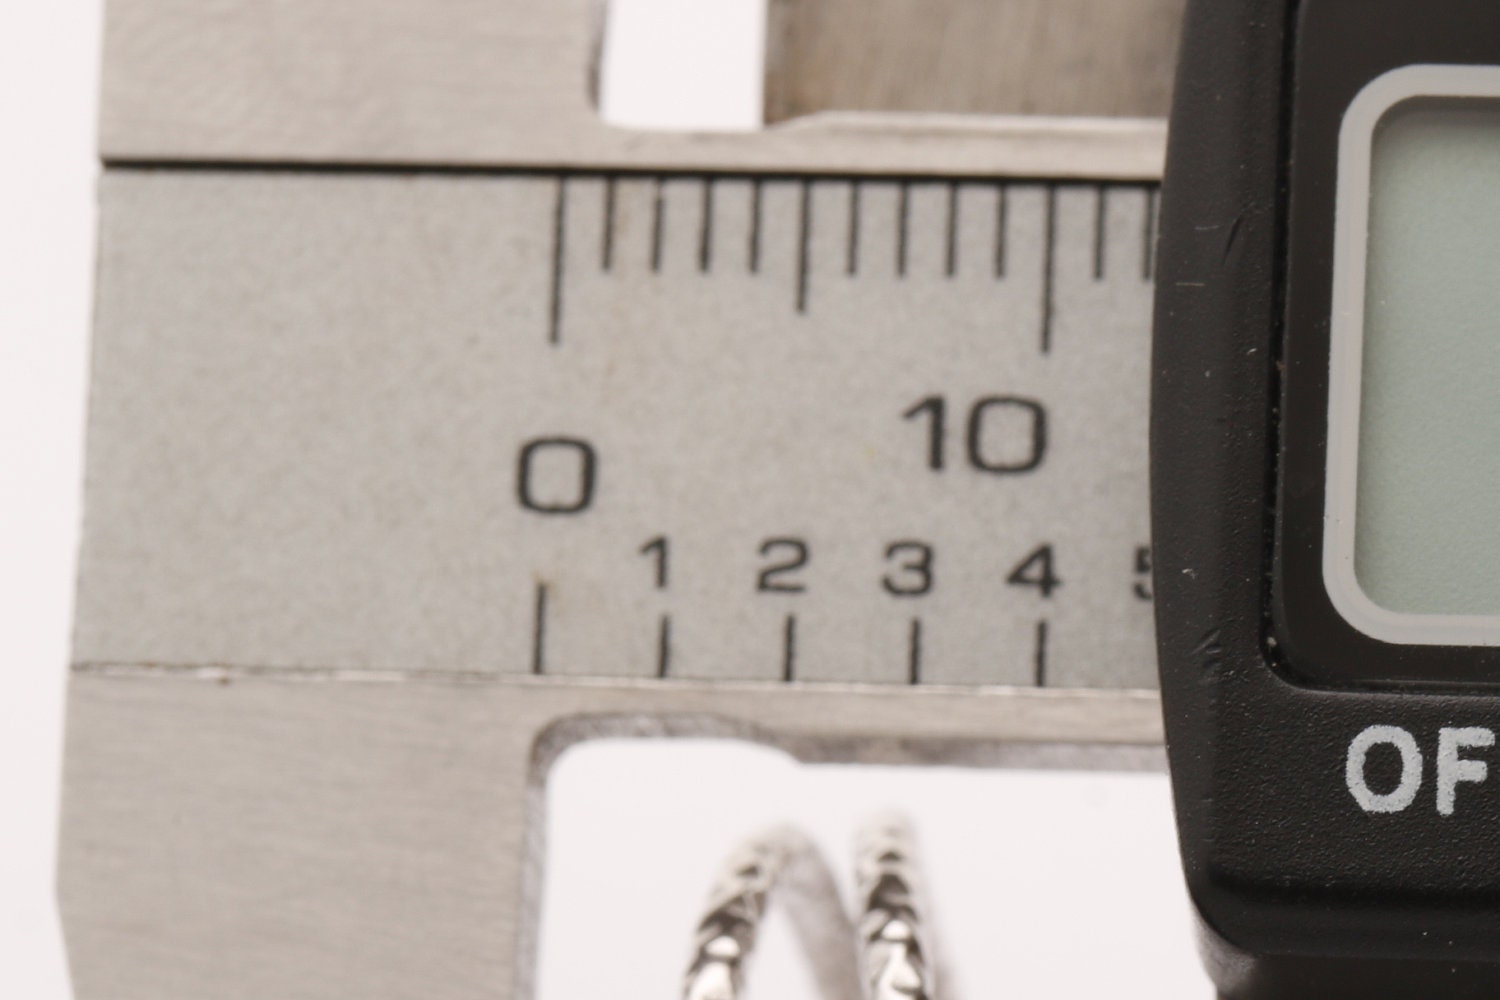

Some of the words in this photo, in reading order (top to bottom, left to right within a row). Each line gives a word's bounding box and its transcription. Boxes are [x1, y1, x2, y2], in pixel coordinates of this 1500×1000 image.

[902, 394, 1048, 475] 10
[515, 435, 597, 516] 0
[638, 536, 670, 590] 1
[756, 537, 811, 594] 2
[881, 539, 935, 598] 3
[1005, 542, 1062, 600] 4
